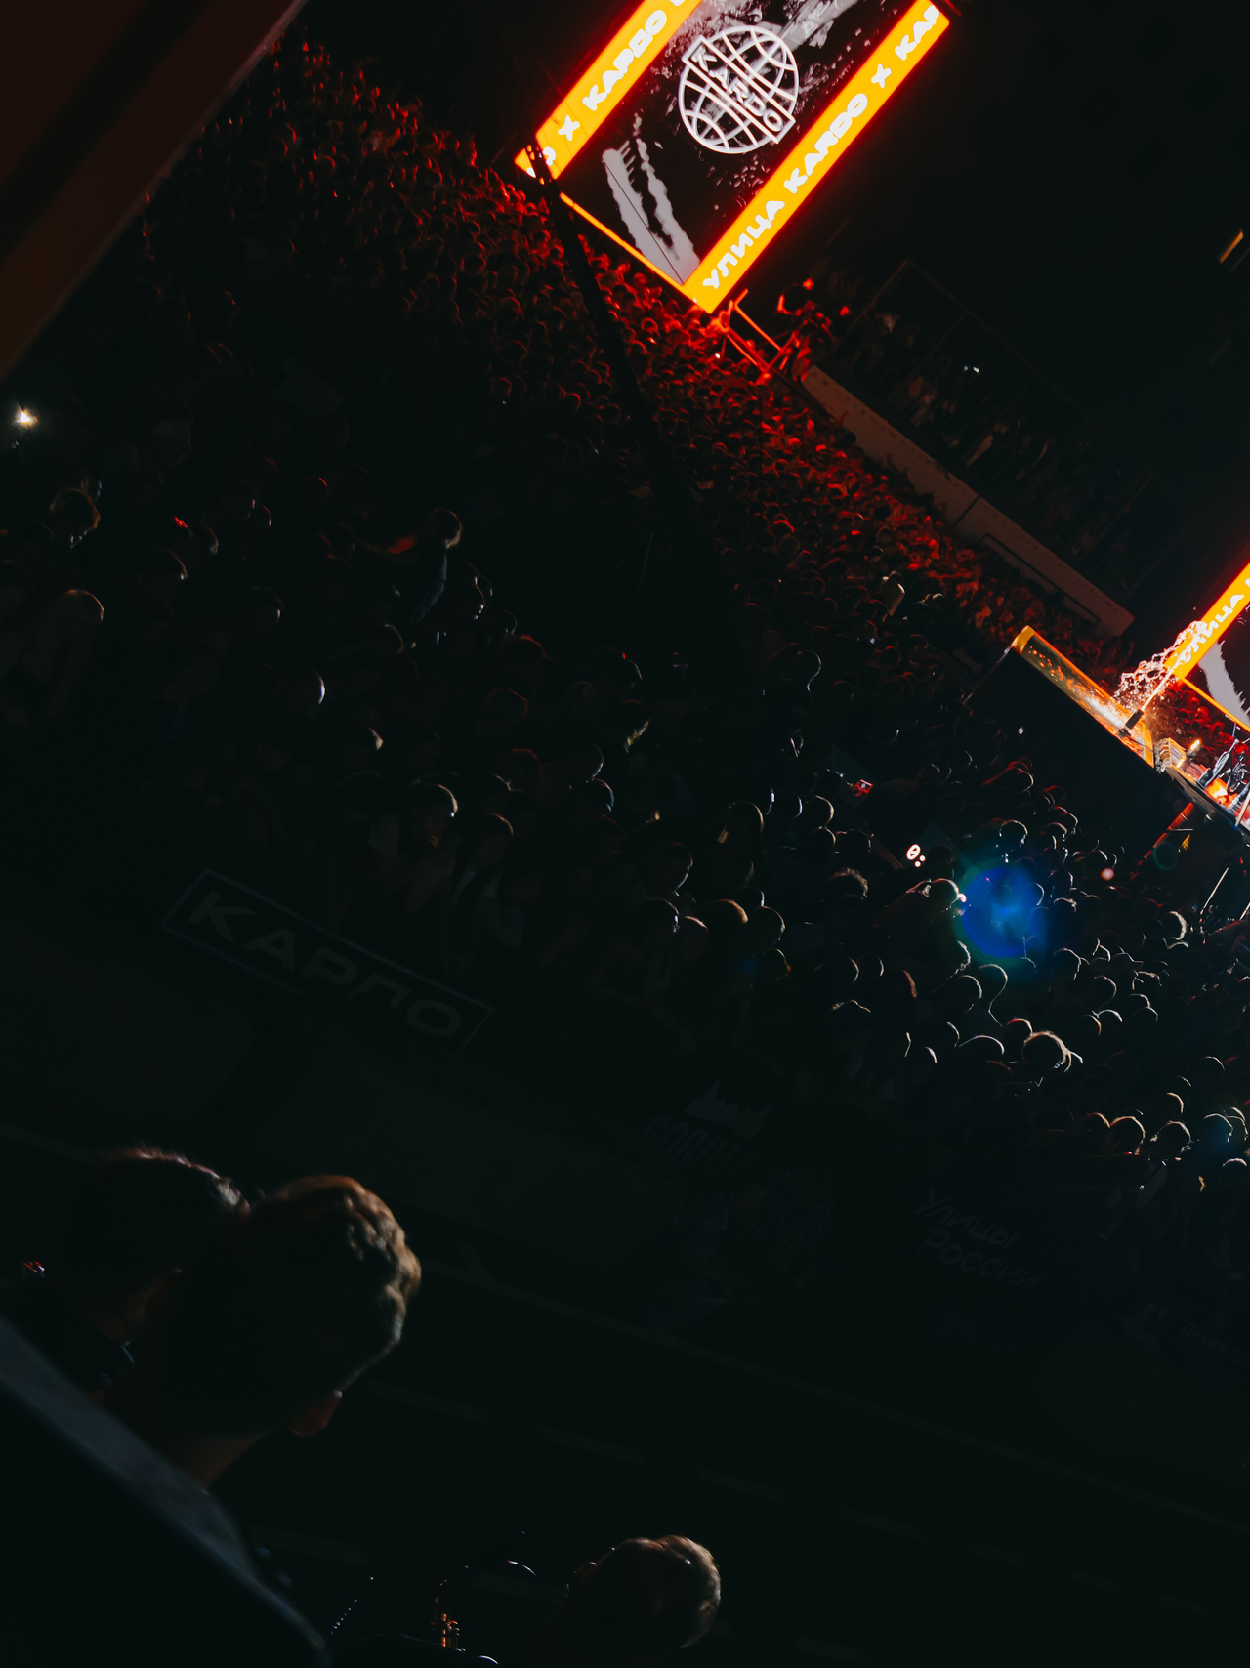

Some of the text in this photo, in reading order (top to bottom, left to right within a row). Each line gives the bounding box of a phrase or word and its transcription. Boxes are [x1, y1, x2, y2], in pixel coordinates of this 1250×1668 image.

[690, 44, 783, 132] KARDO
[703, 201, 785, 289] УЛИЦА
[783, 94, 868, 193] KARDO
